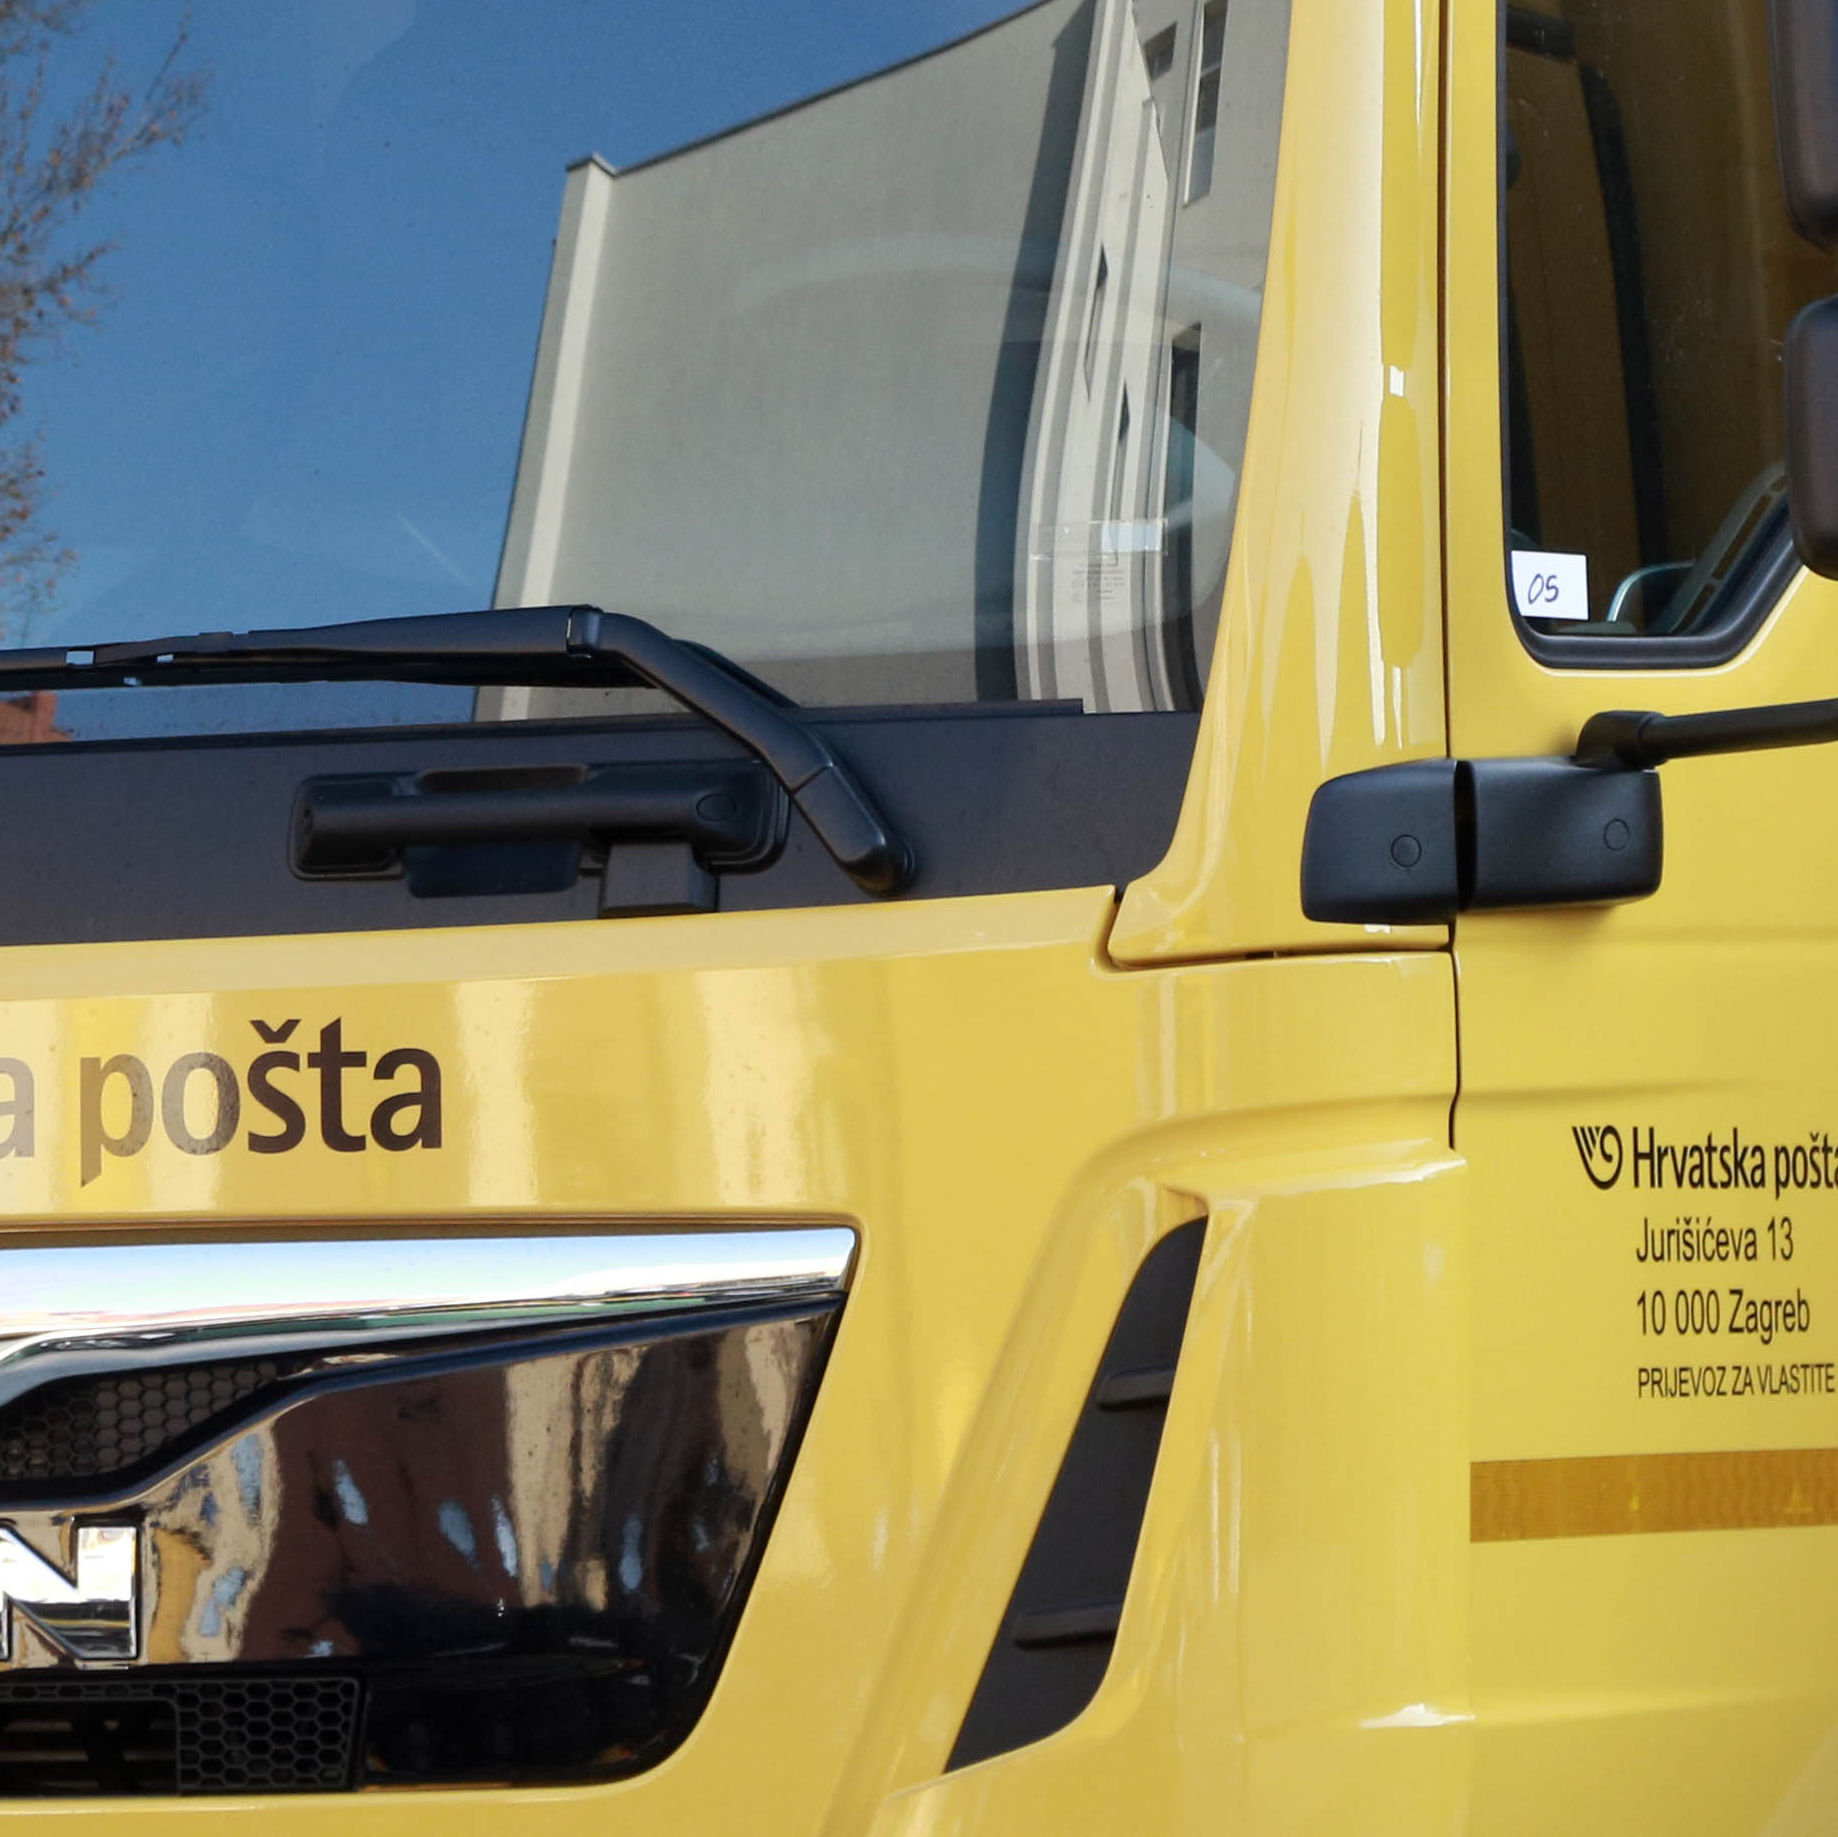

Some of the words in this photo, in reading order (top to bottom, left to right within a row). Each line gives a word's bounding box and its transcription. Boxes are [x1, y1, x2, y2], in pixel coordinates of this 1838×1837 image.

[80, 1017, 444, 1188] pošta
[1631, 1125, 1766, 1189] Hrvatska
[1635, 1216, 1758, 1263] Jurišićeva
[1766, 1215, 1795, 1261] 13
[1636, 1288, 1666, 1336] 10
[1674, 1288, 1721, 1336] 000
[1727, 1287, 1811, 1346] Zagreb
[1637, 1364, 1728, 1399] PRIJEVOZ
[1730, 1365, 1755, 1397] ZA
[1755, 1362, 1836, 1396] VLASTITE
